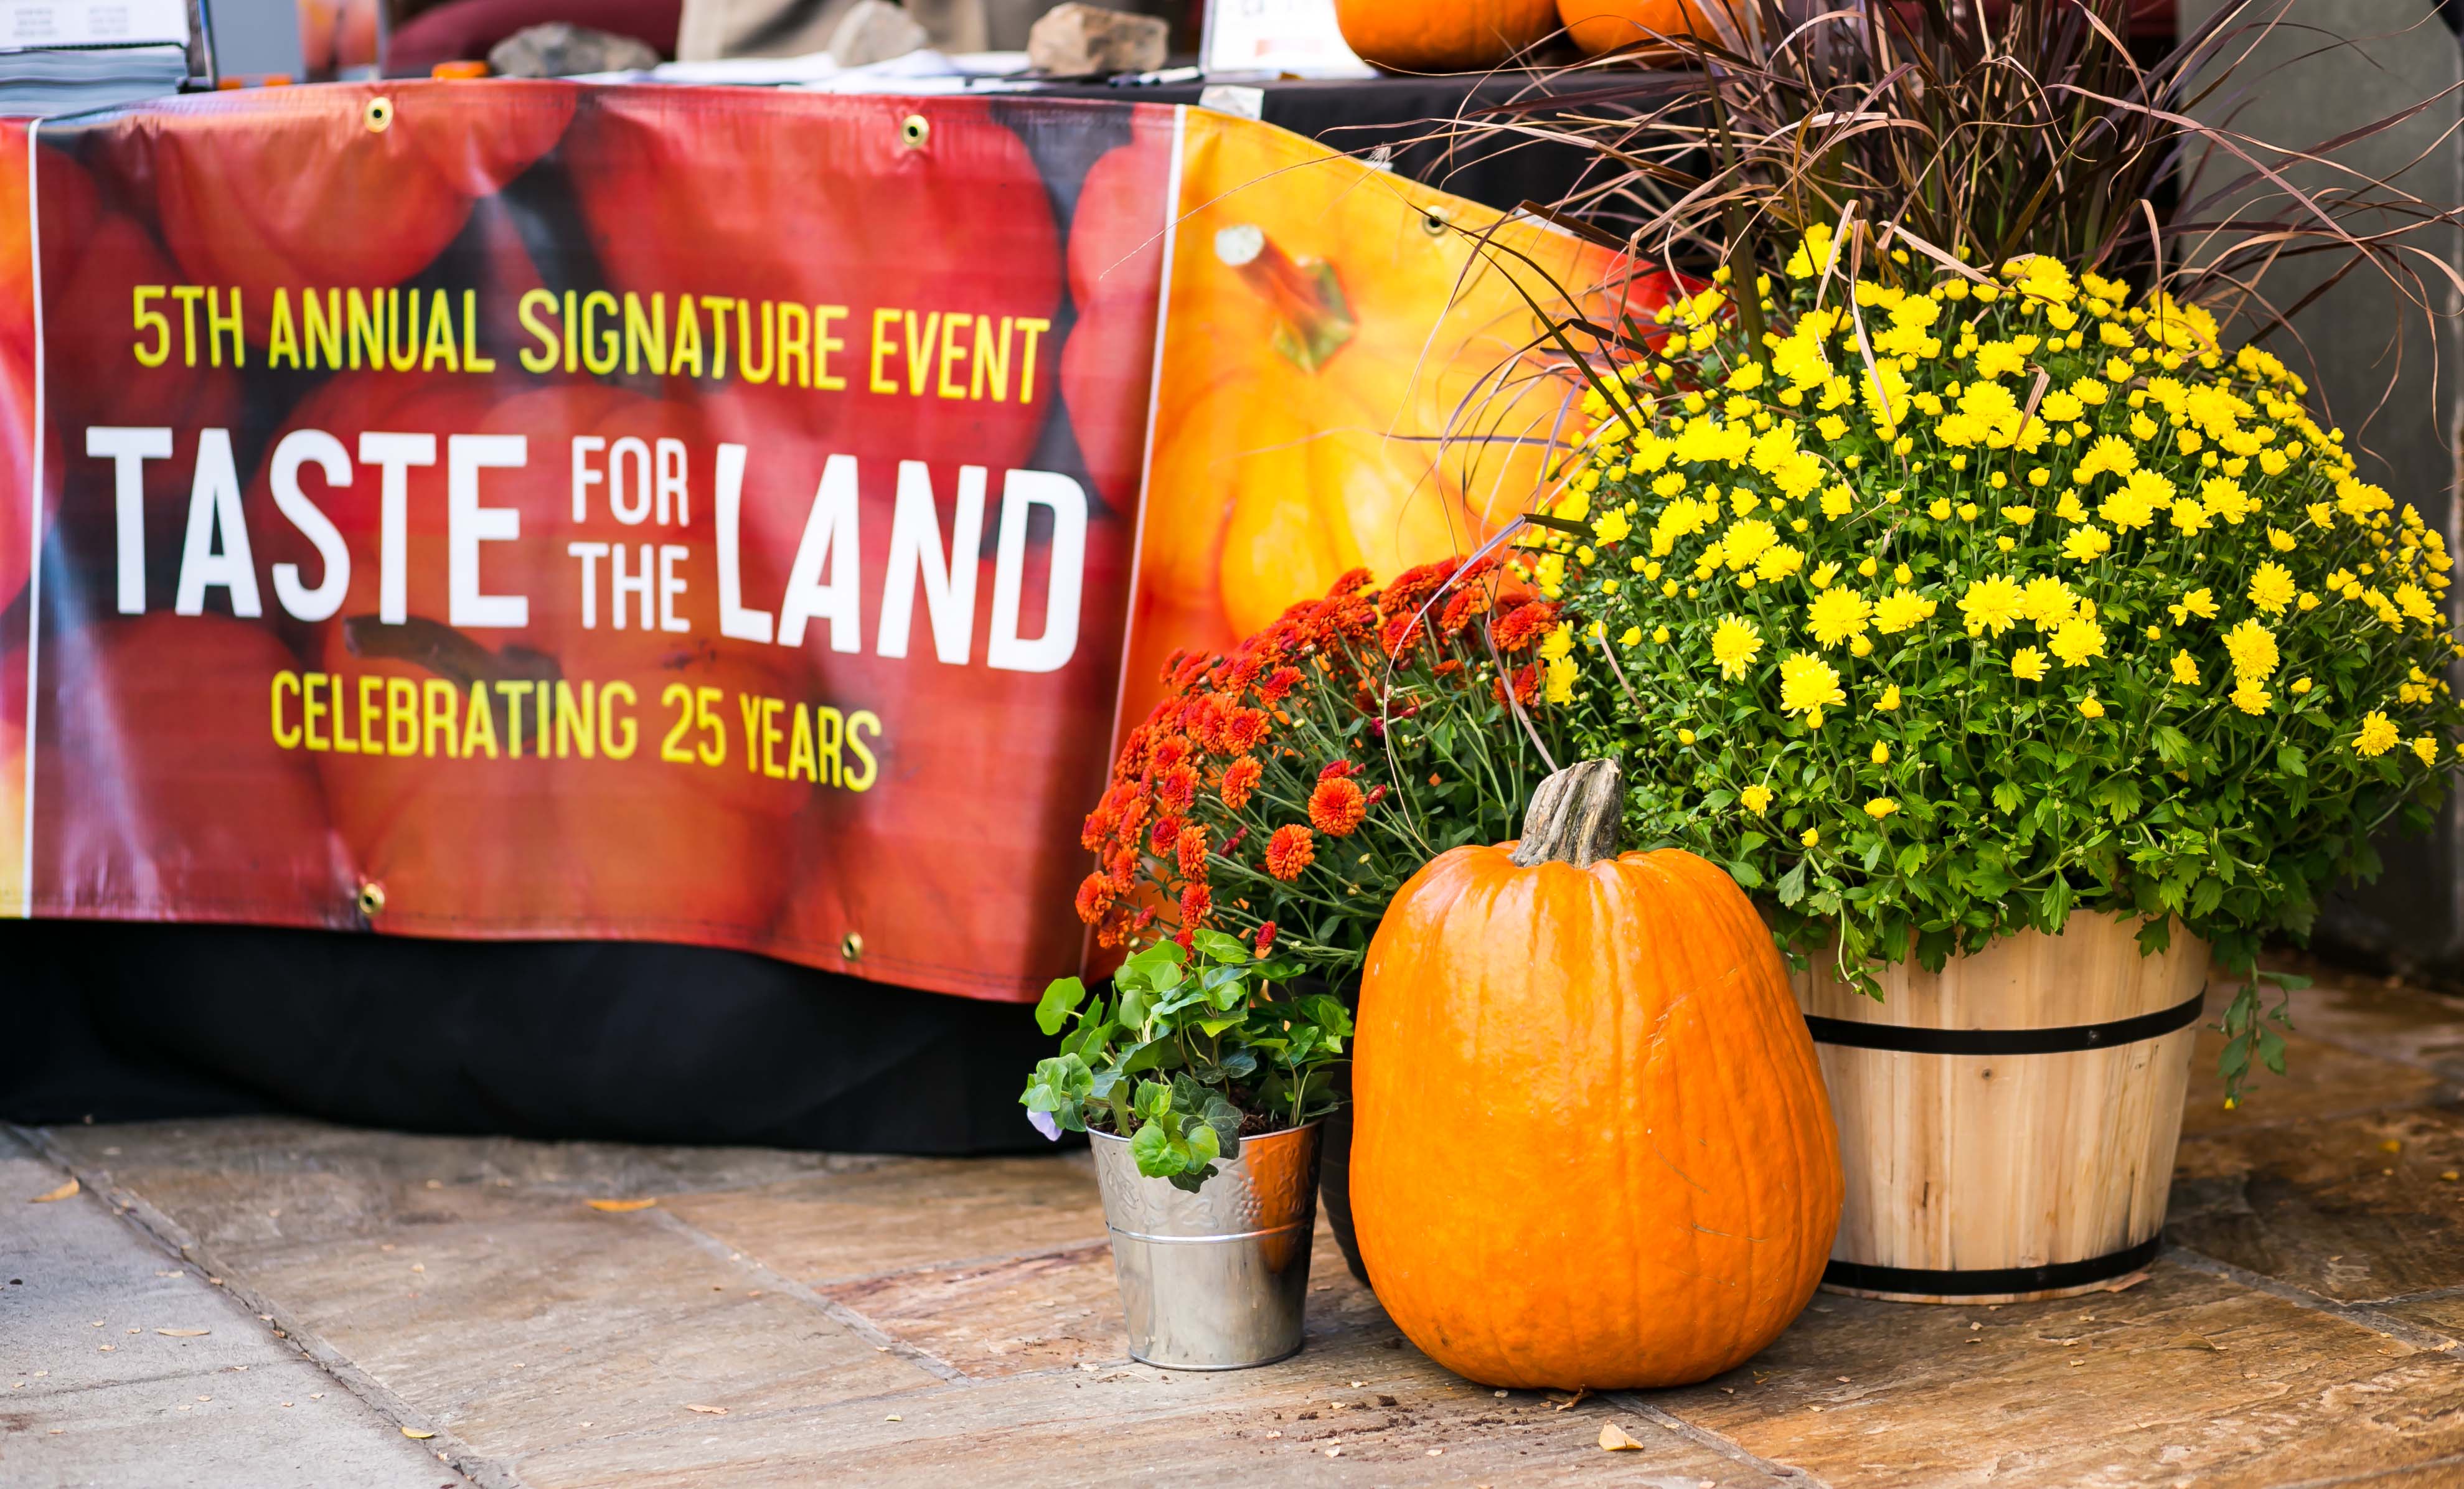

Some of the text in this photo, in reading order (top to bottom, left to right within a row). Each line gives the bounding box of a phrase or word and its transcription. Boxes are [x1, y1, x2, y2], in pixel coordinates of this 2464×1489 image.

[133, 285, 1051, 405] 5TH ANNUAL SIGNATURE EVENT
[86, 426, 1088, 674] TASTE FOR THE LAND
[271, 670, 883, 793] CELEBRATING 25 YEARS
